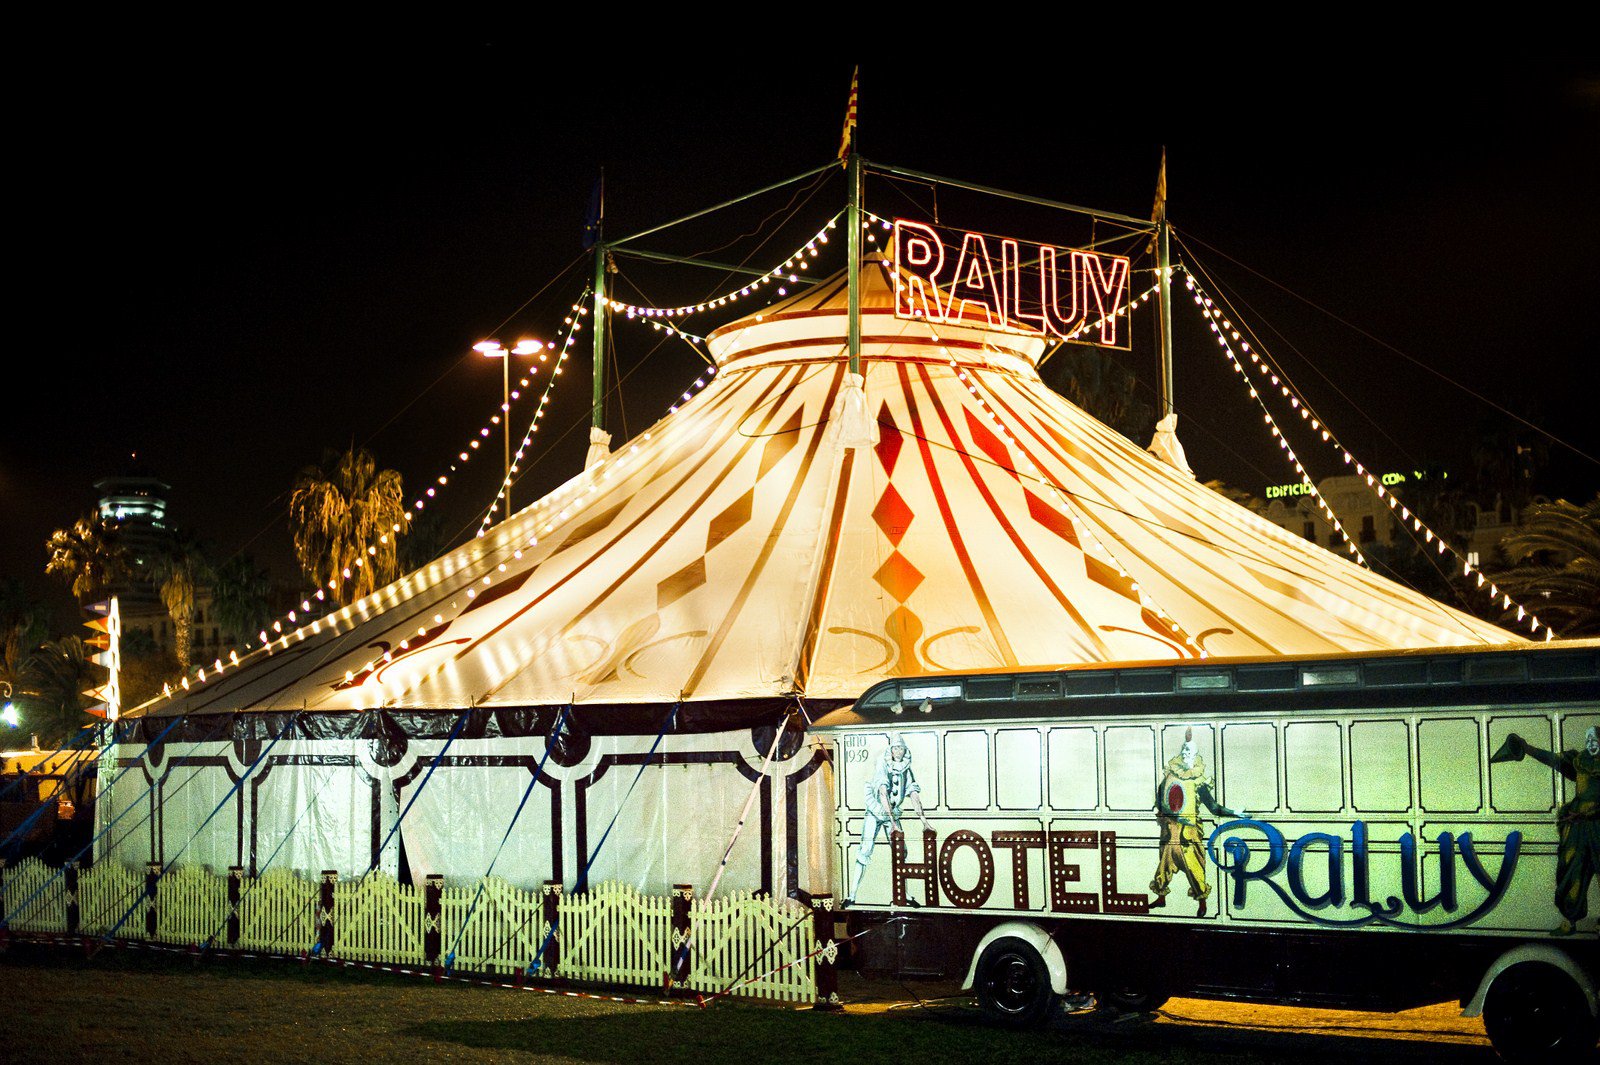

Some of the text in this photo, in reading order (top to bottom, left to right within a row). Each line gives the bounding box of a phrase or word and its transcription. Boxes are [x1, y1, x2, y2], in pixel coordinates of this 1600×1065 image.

[894, 218, 1129, 345] RALUY
[1265, 482, 1312, 499] EDIFICIO
[891, 829, 1150, 914] HOTEL
